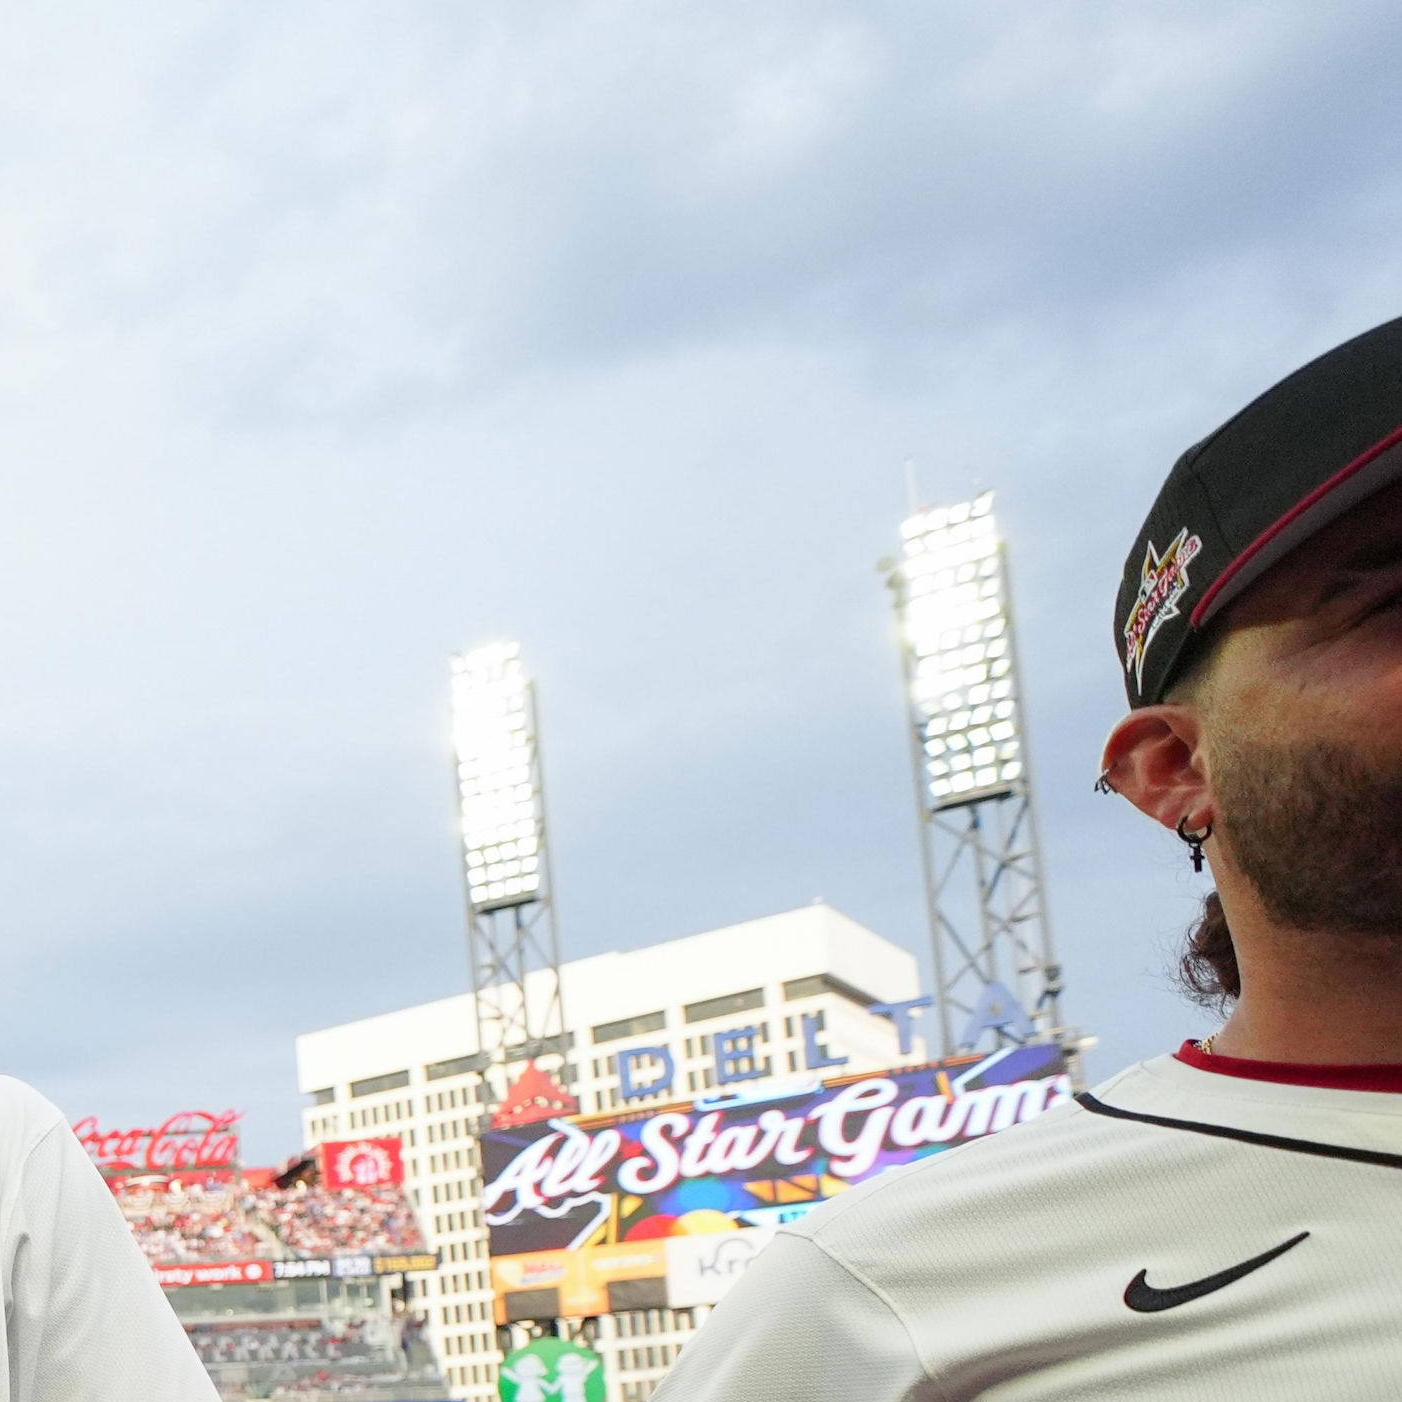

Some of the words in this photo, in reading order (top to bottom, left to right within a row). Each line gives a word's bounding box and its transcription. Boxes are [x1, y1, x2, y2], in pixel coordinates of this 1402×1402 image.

[616, 977, 1037, 1102] DELTA
[483, 1125, 623, 1213] All
[616, 1112, 818, 1196] Star
